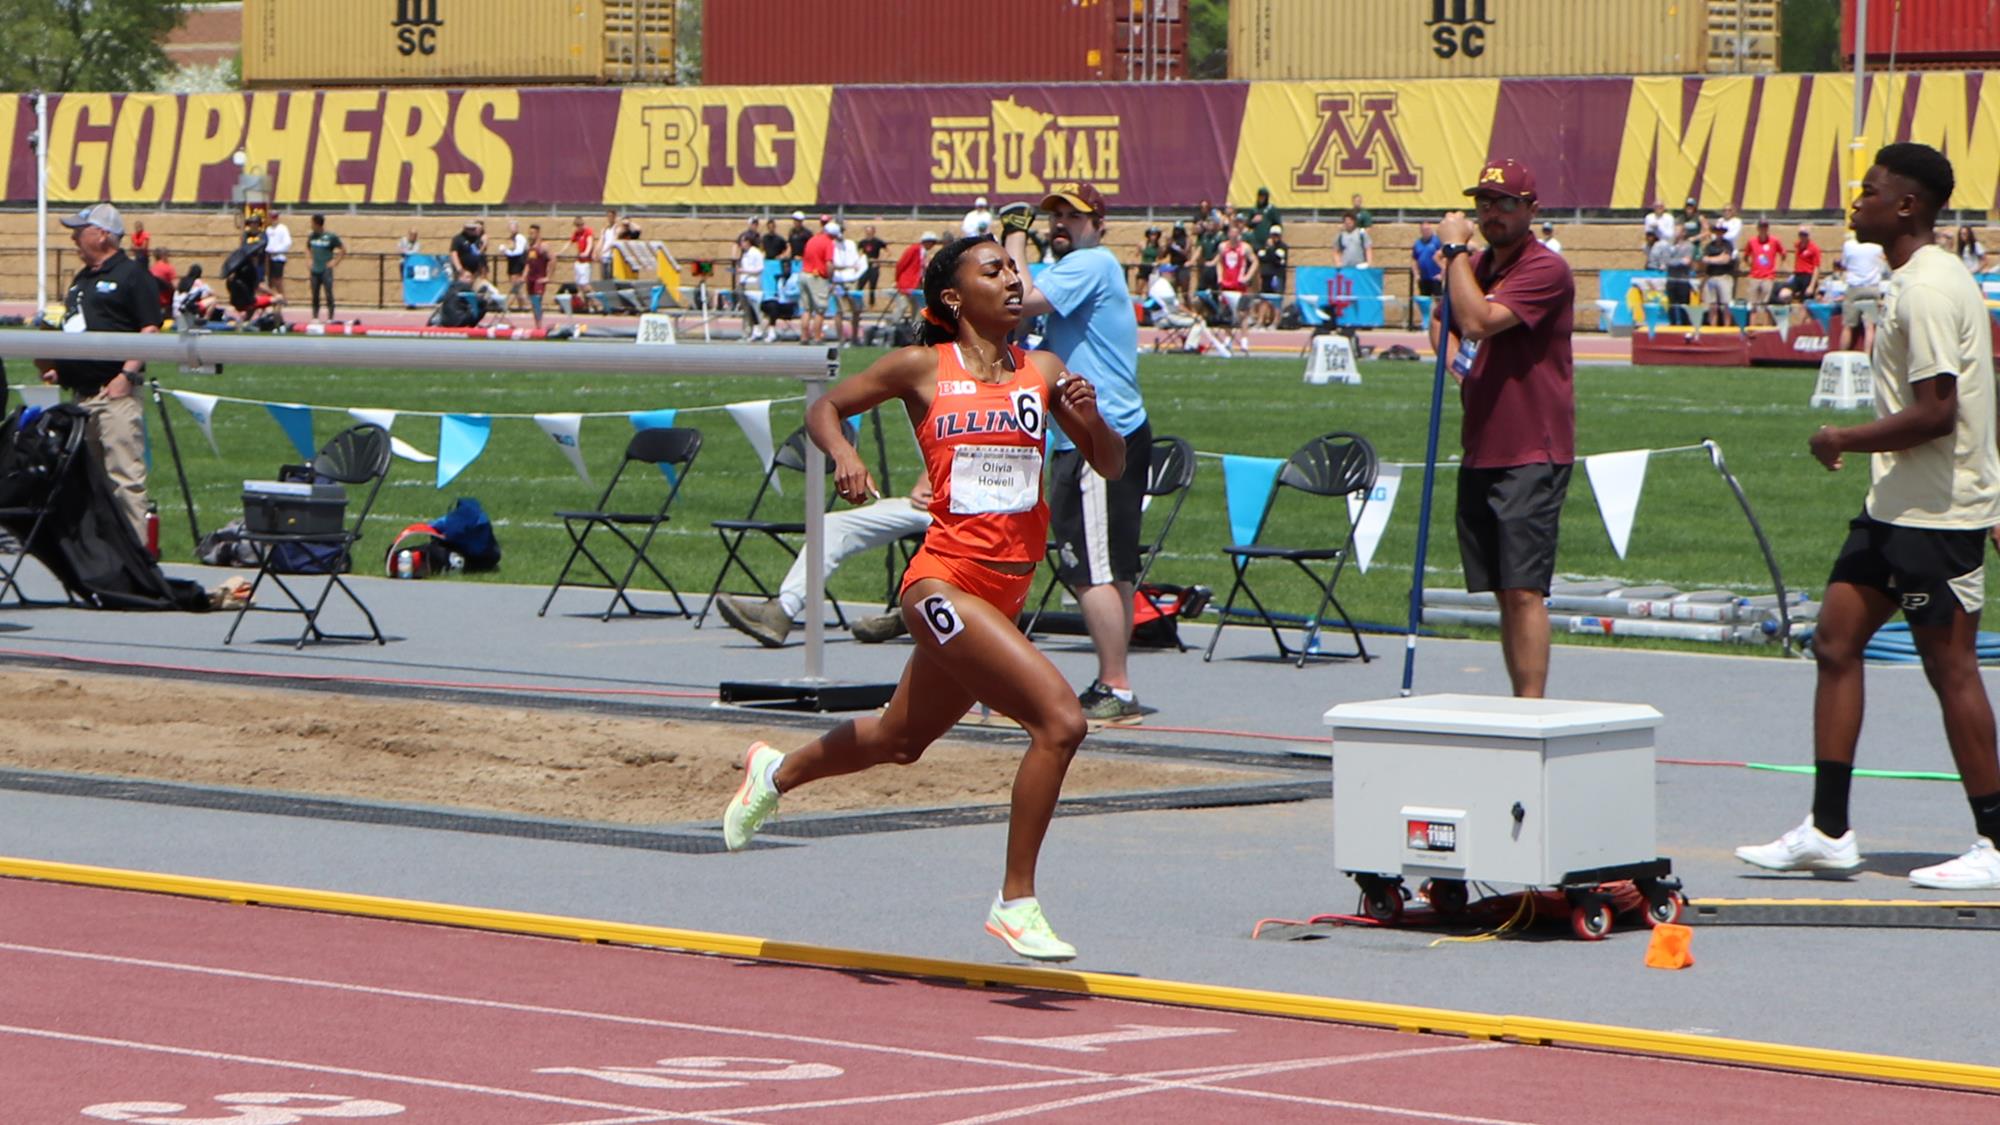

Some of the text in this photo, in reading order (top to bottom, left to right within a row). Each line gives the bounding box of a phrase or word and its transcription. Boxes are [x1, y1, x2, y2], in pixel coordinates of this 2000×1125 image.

[44, 89, 522, 204] GOPHERS
[930, 130, 990, 180] SKI
[1002, 132, 1025, 180] U
[1290, 91, 1424, 192] M
[935, 409, 1020, 440] ILLIN
[1016, 393, 1039, 434] 6
[978, 476, 1014, 487] Howell
[982, 462, 1013, 473] Olivia
[924, 596, 955, 635] 6
[1902, 592, 1929, 610] P
